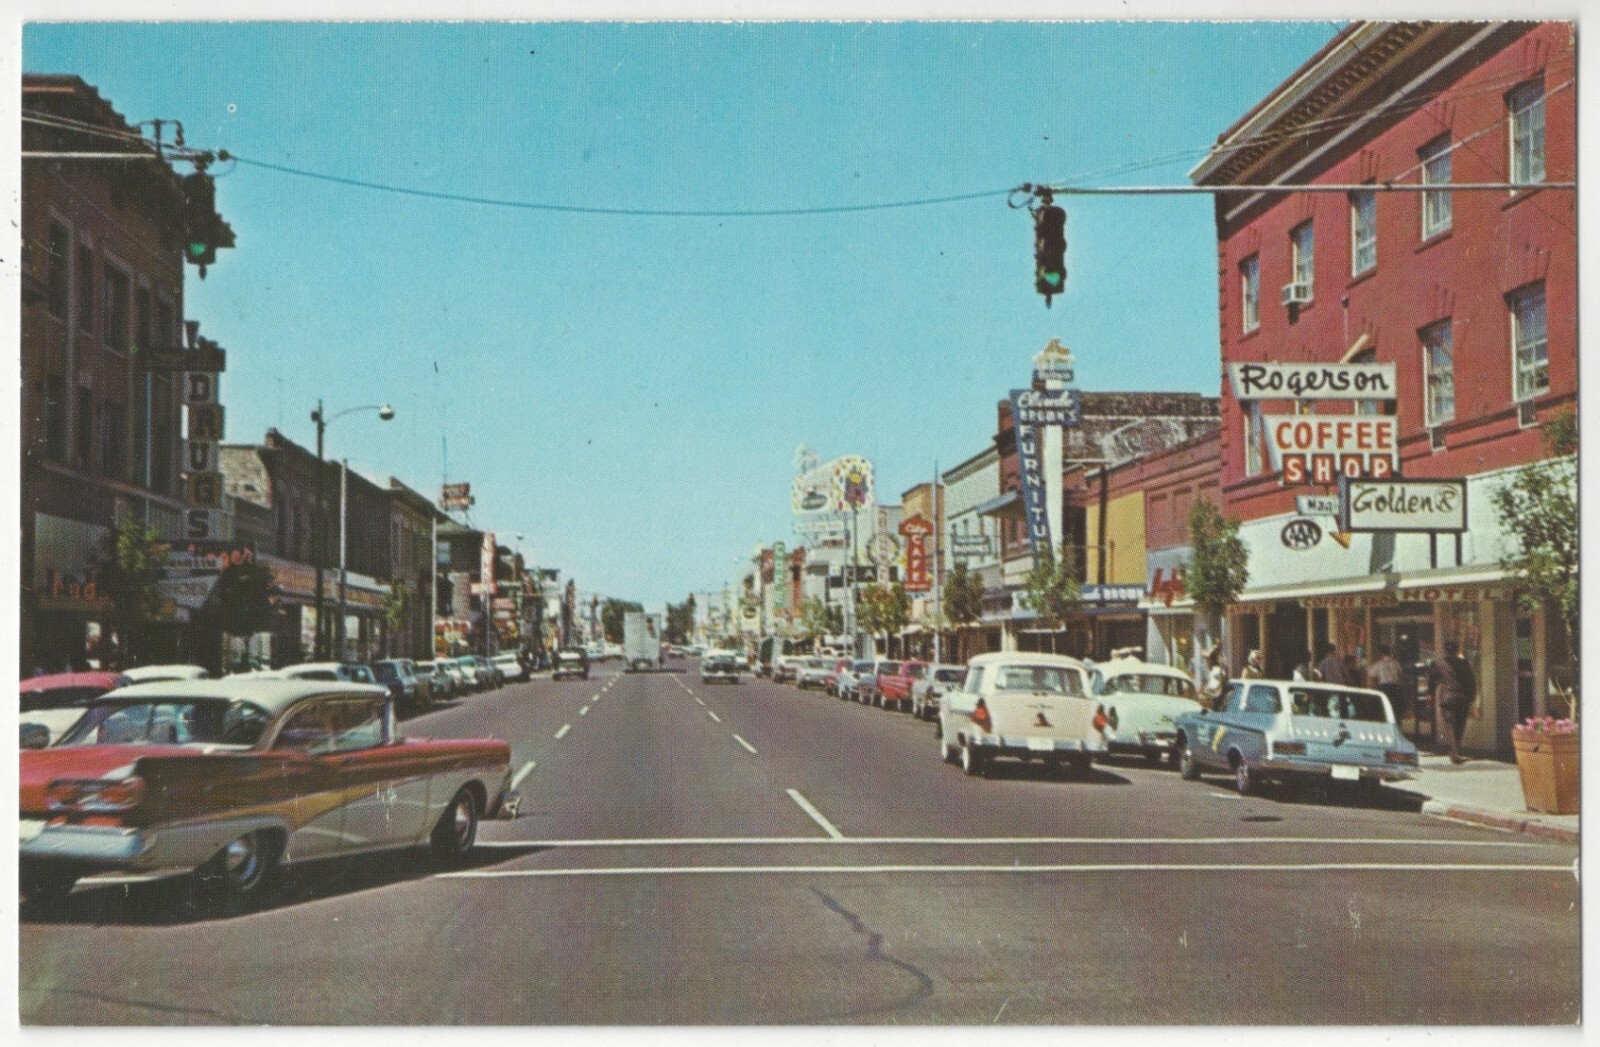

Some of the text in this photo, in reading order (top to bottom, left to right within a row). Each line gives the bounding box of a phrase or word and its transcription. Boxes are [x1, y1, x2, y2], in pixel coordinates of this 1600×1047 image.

[1240, 364, 1389, 396] Rogerson
[1275, 421, 1392, 450] COFFEE
[189, 374, 217, 538] DRUGS
[1286, 459, 1390, 481] SHOP
[1019, 424, 1049, 553] FURNITU
[1352, 485, 1434, 513] Golden
[912, 533, 922, 581] CAFE
[1402, 587, 1497, 601] HOTEL
